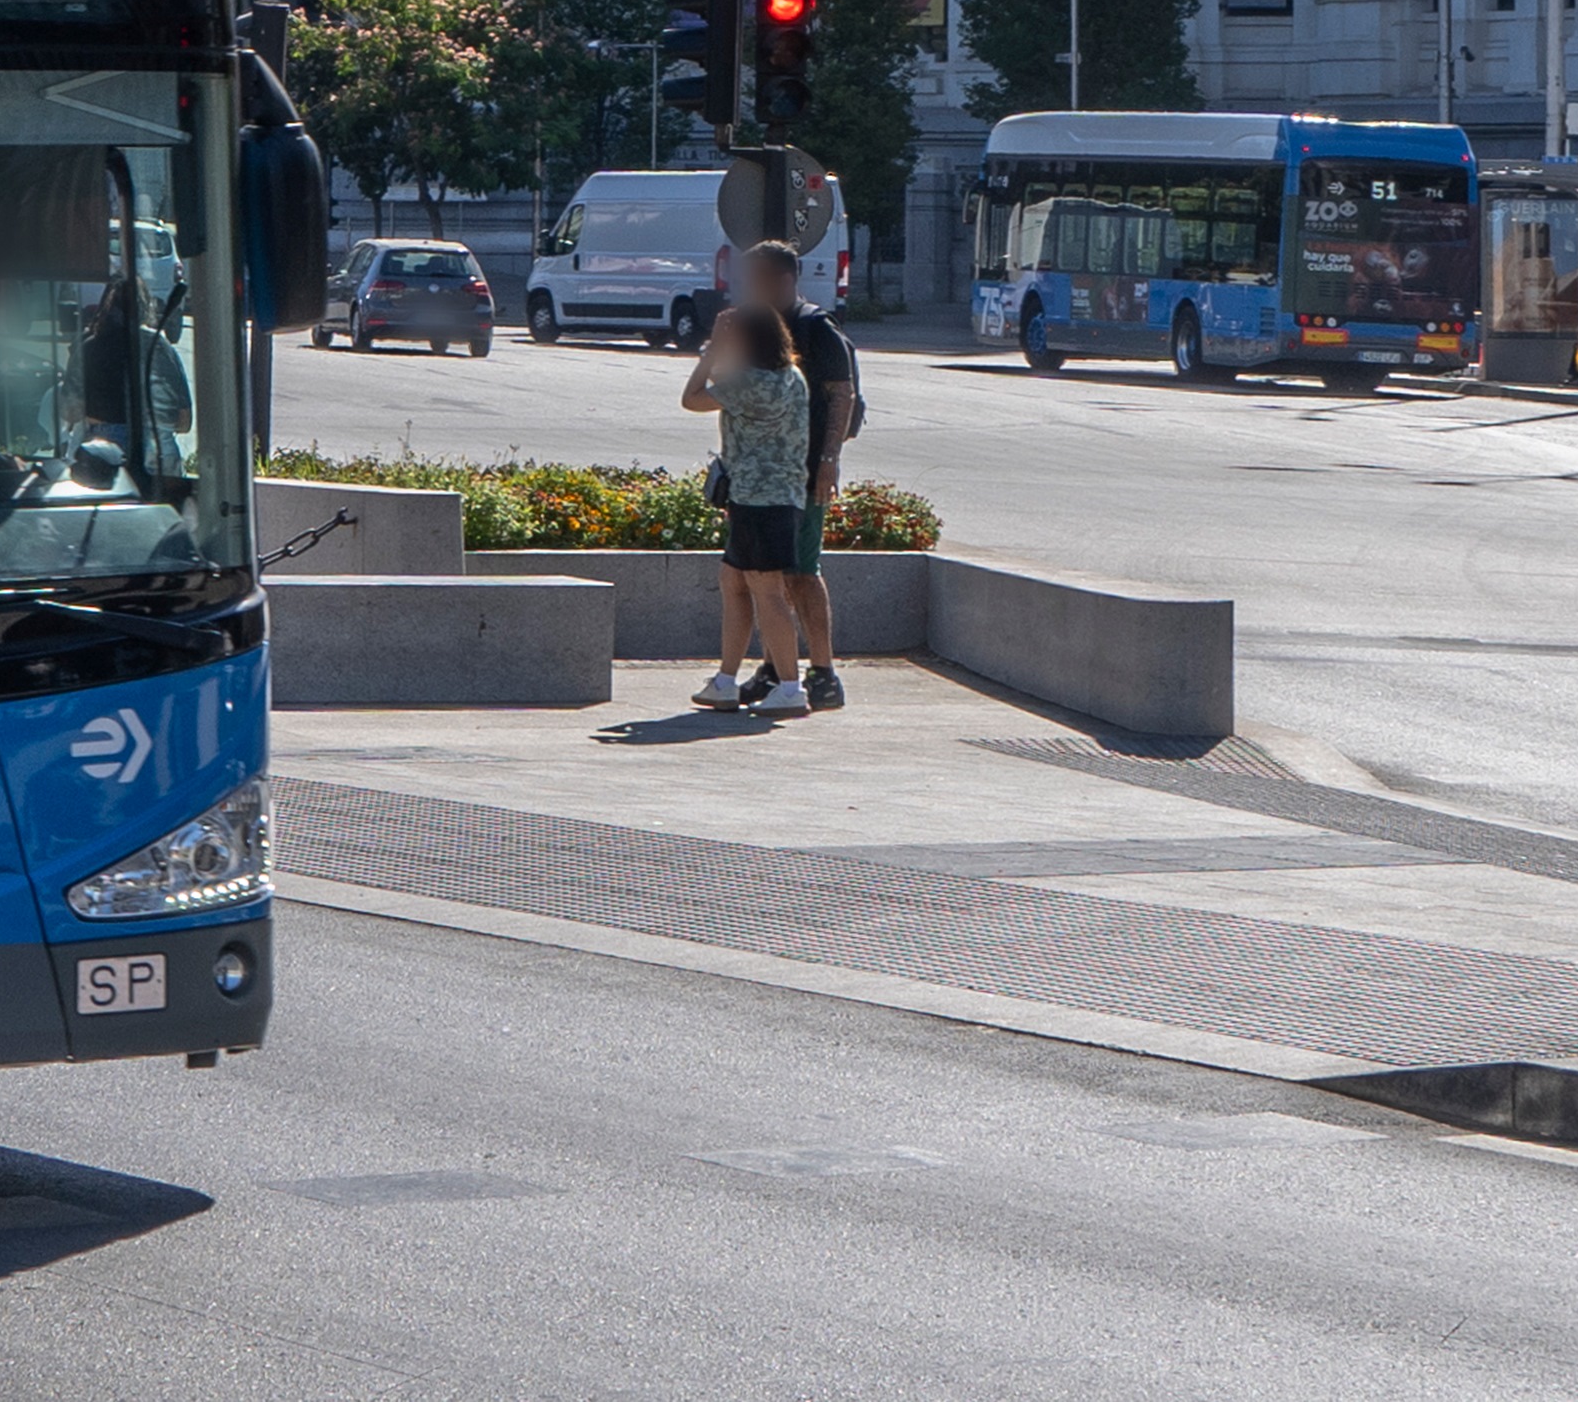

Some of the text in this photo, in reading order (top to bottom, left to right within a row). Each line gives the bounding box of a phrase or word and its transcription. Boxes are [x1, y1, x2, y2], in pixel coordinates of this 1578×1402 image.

[1371, 181, 1398, 200] 51
[1499, 201, 1575, 214] GUERLAIN
[1328, 254, 1351, 263] que
[89, 962, 155, 1006] SP
